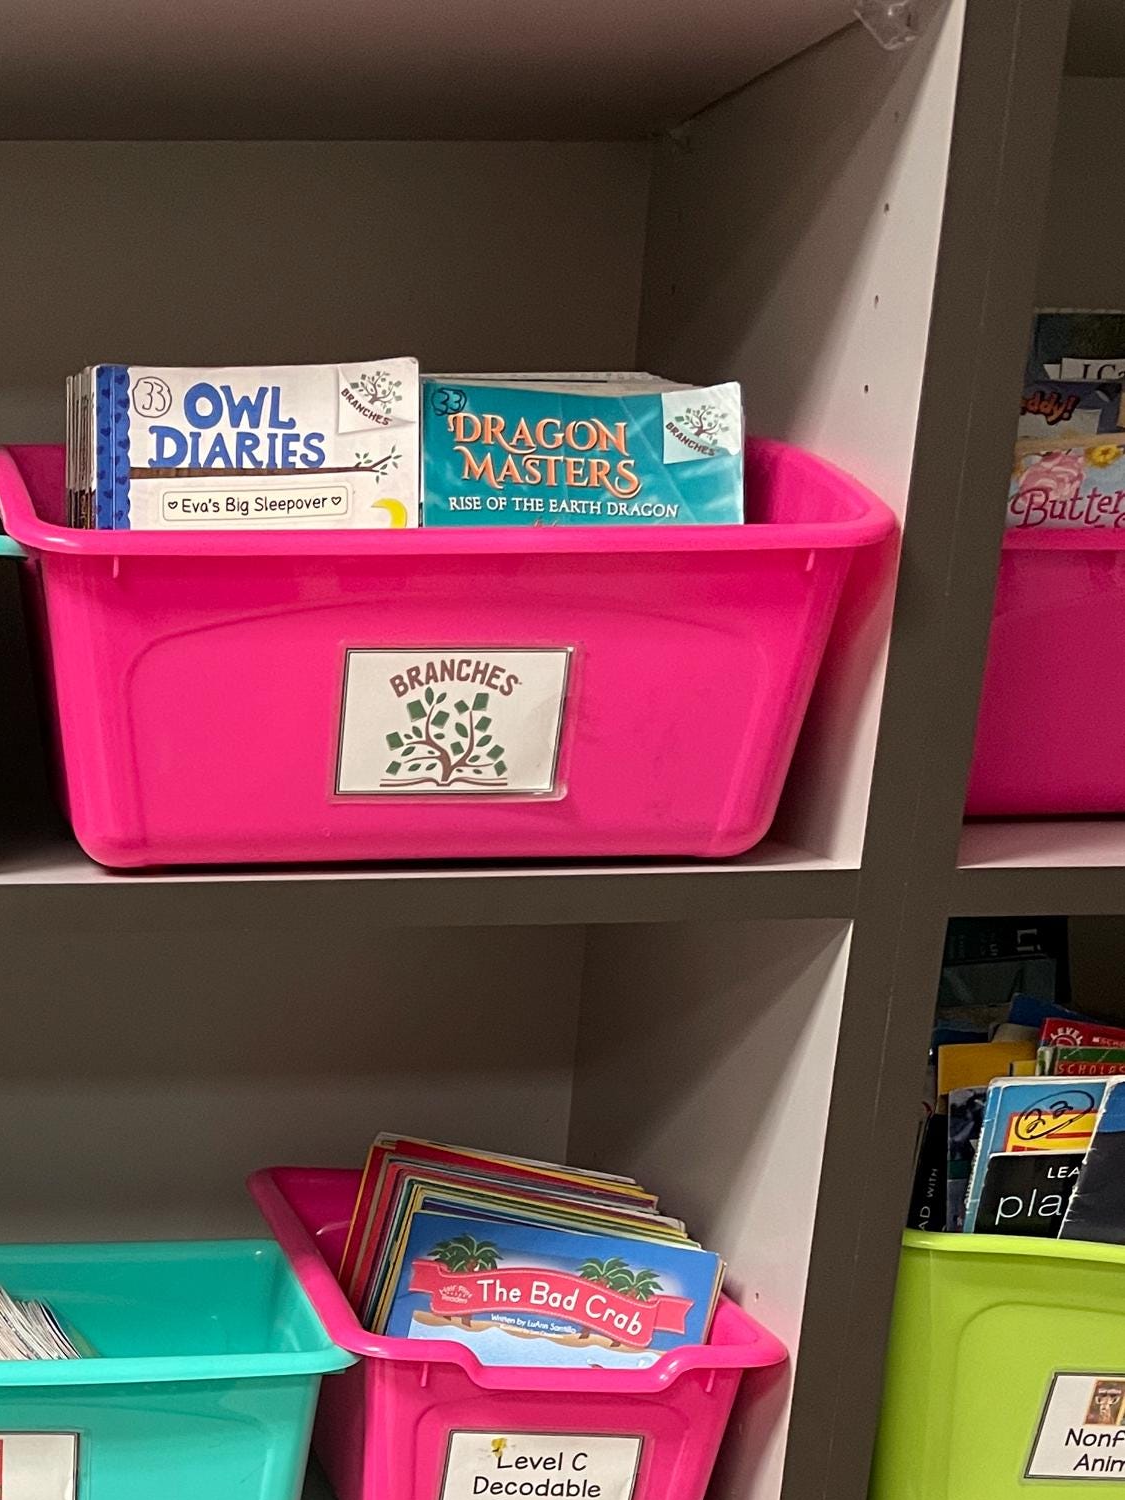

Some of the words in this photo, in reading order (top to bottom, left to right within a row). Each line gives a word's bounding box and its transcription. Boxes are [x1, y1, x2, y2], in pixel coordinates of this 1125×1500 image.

[183, 382, 296, 430] OWL
[340, 388, 394, 427] BRANCHES
[148, 425, 326, 469] DIARIES
[447, 412, 630, 456] DRAGON
[666, 421, 717, 457] BRANCHES
[453, 446, 643, 499] MASTERS
[181, 497, 220, 514] Eva's
[225, 496, 249, 516] Big
[253, 495, 329, 519] Sleepover
[448, 496, 483, 512] RISE
[486, 496, 508, 512] OF
[511, 497, 545, 513] THE
[548, 499, 604, 515] EARTH
[606, 501, 679, 519] DRAGON
[389, 659, 519, 698] BRANCHES
[927, 1168, 939, 1198] WITH
[1047, 1167, 1080, 1179] LEA
[476, 1279, 522, 1302] The
[530, 1281, 580, 1311] Bad
[585, 1295, 642, 1335] Crab
[491, 1313, 516, 1324] Written
[517, 1318, 526, 1327] by
[527, 1319, 548, 1330] LuAnn
[549, 1322, 577, 1334] Santillo
[497, 1452, 564, 1470] Level
[572, 1453, 588, 1471] C
[473, 1476, 601, 1498] Decodable
